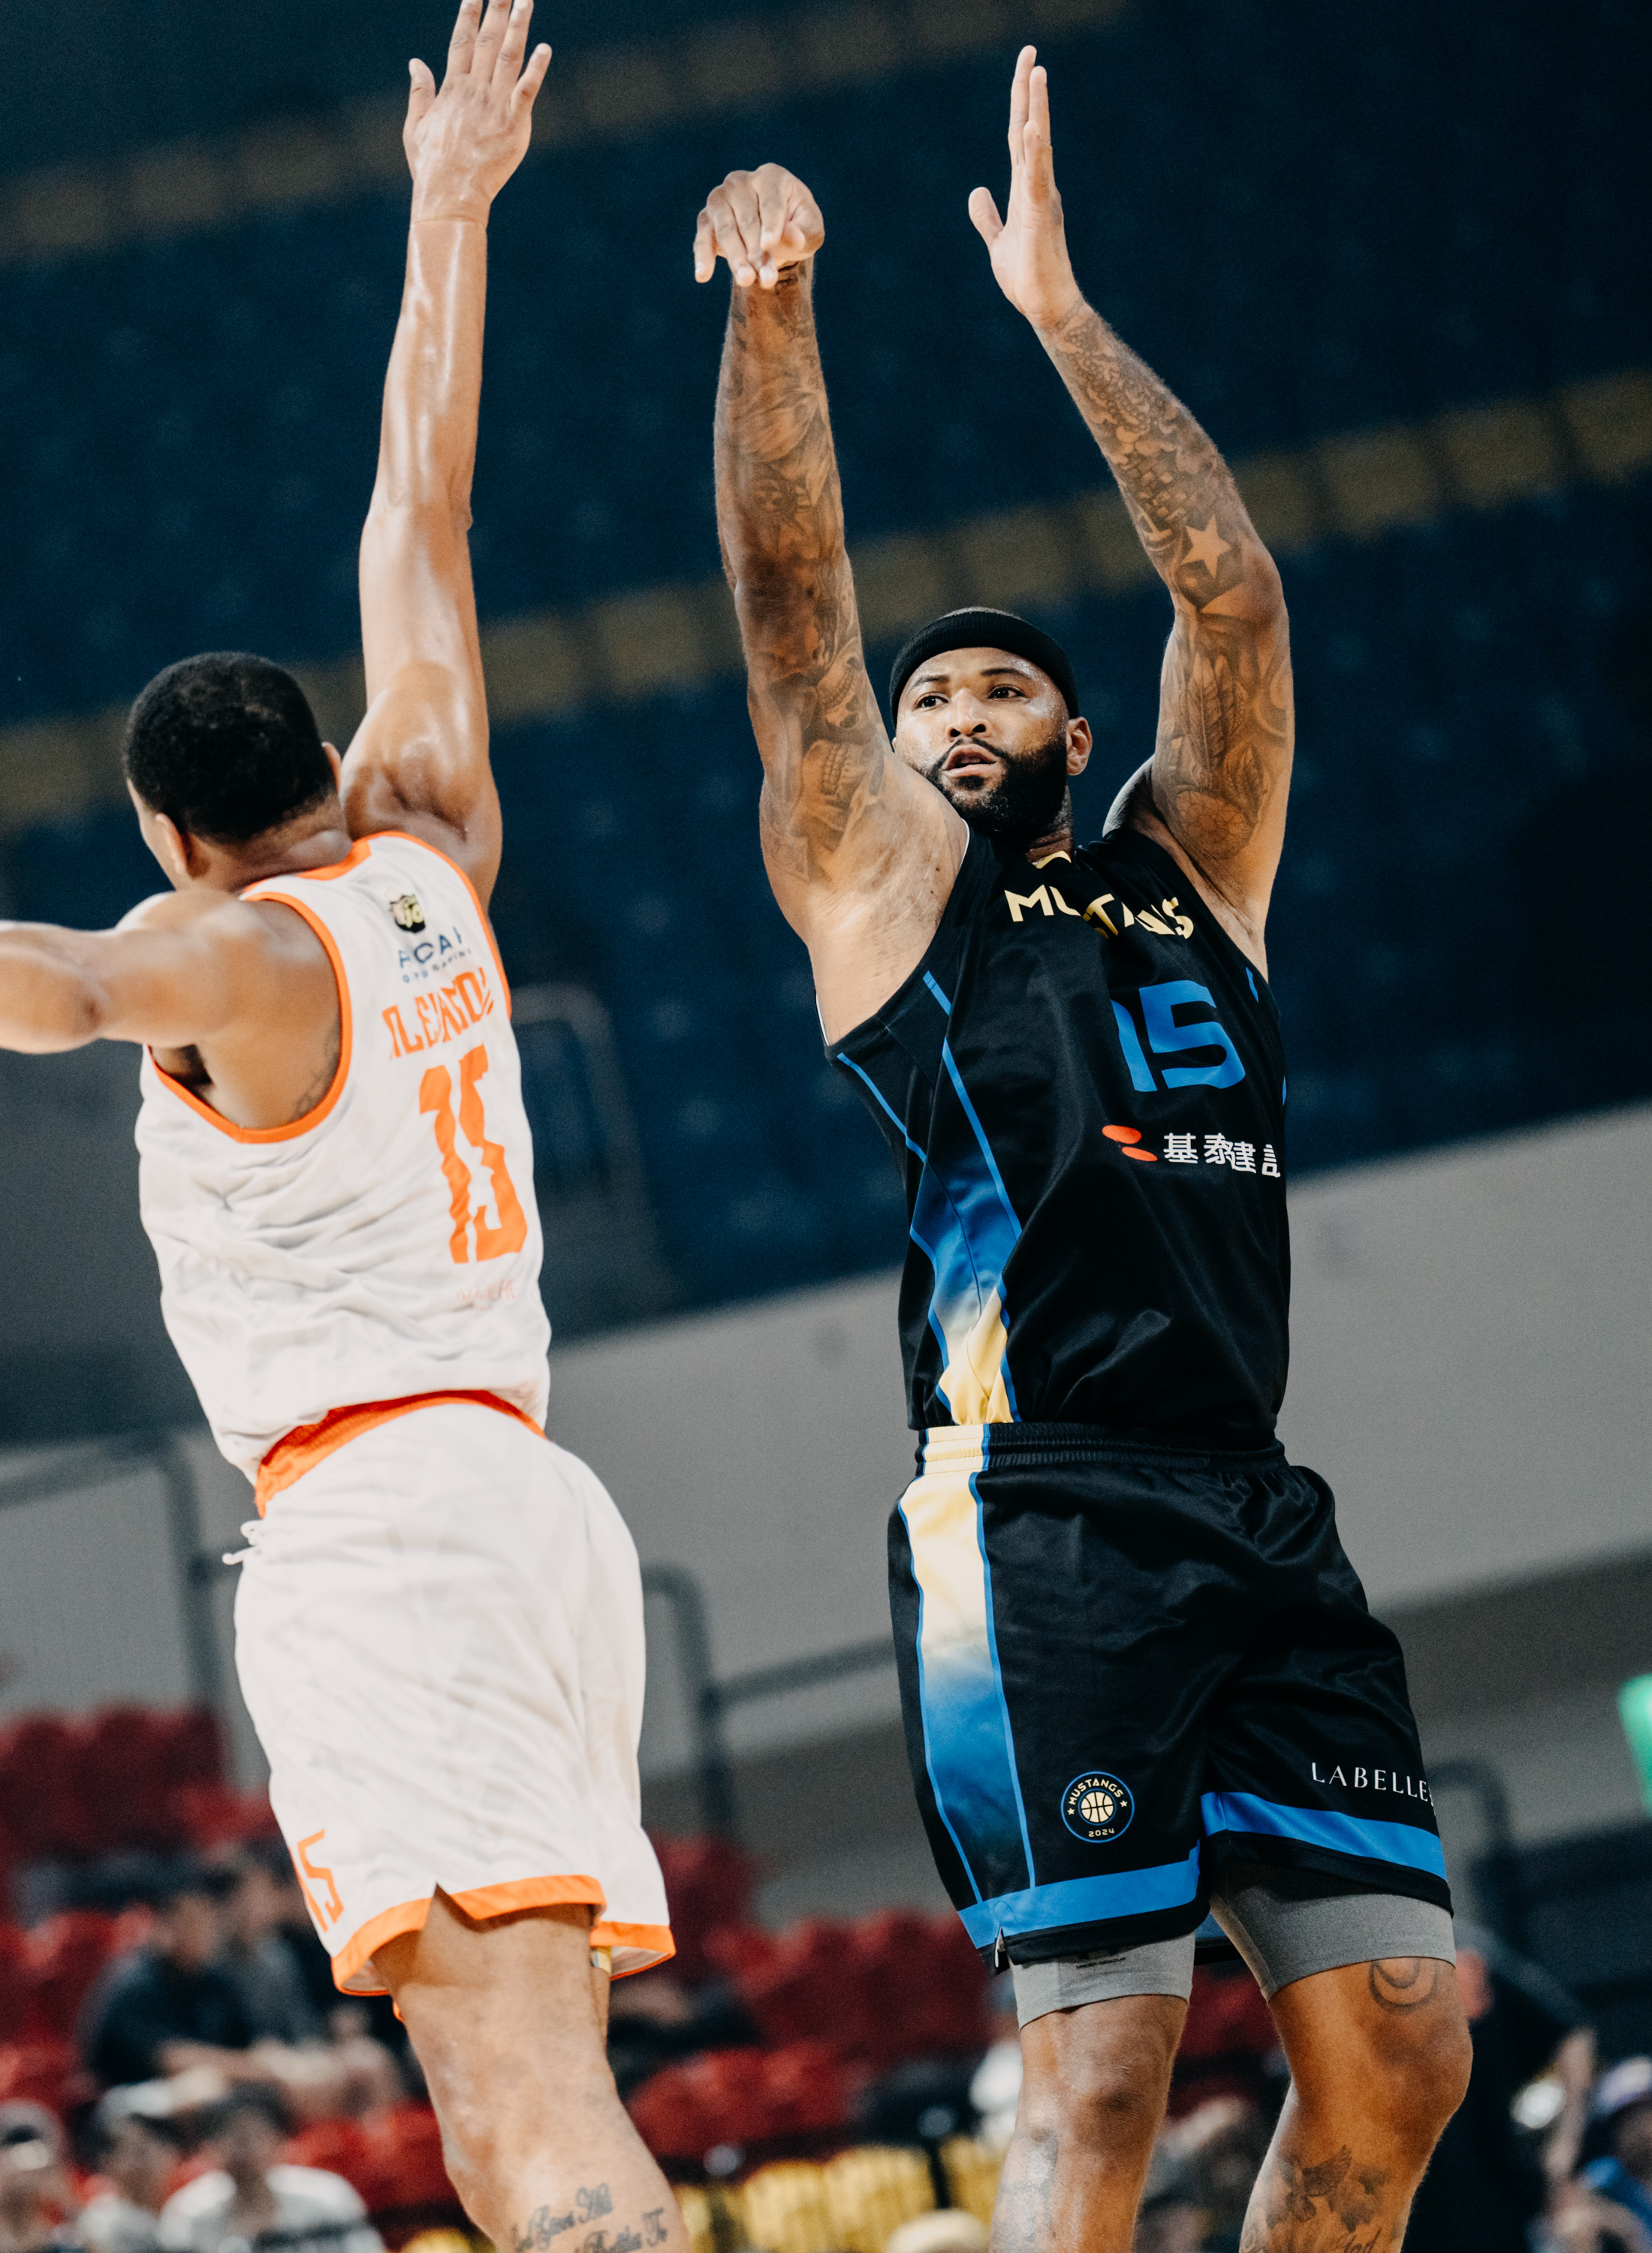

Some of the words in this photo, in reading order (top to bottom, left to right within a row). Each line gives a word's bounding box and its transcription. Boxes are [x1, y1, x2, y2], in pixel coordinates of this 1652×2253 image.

[1111, 979, 1247, 1093] 15
[420, 1041, 528, 1264] 15
[1068, 1778, 1124, 1805] MUSTANGS
[1311, 1762, 1433, 1807] LABELLE
[1088, 1828, 1115, 1838] 2024
